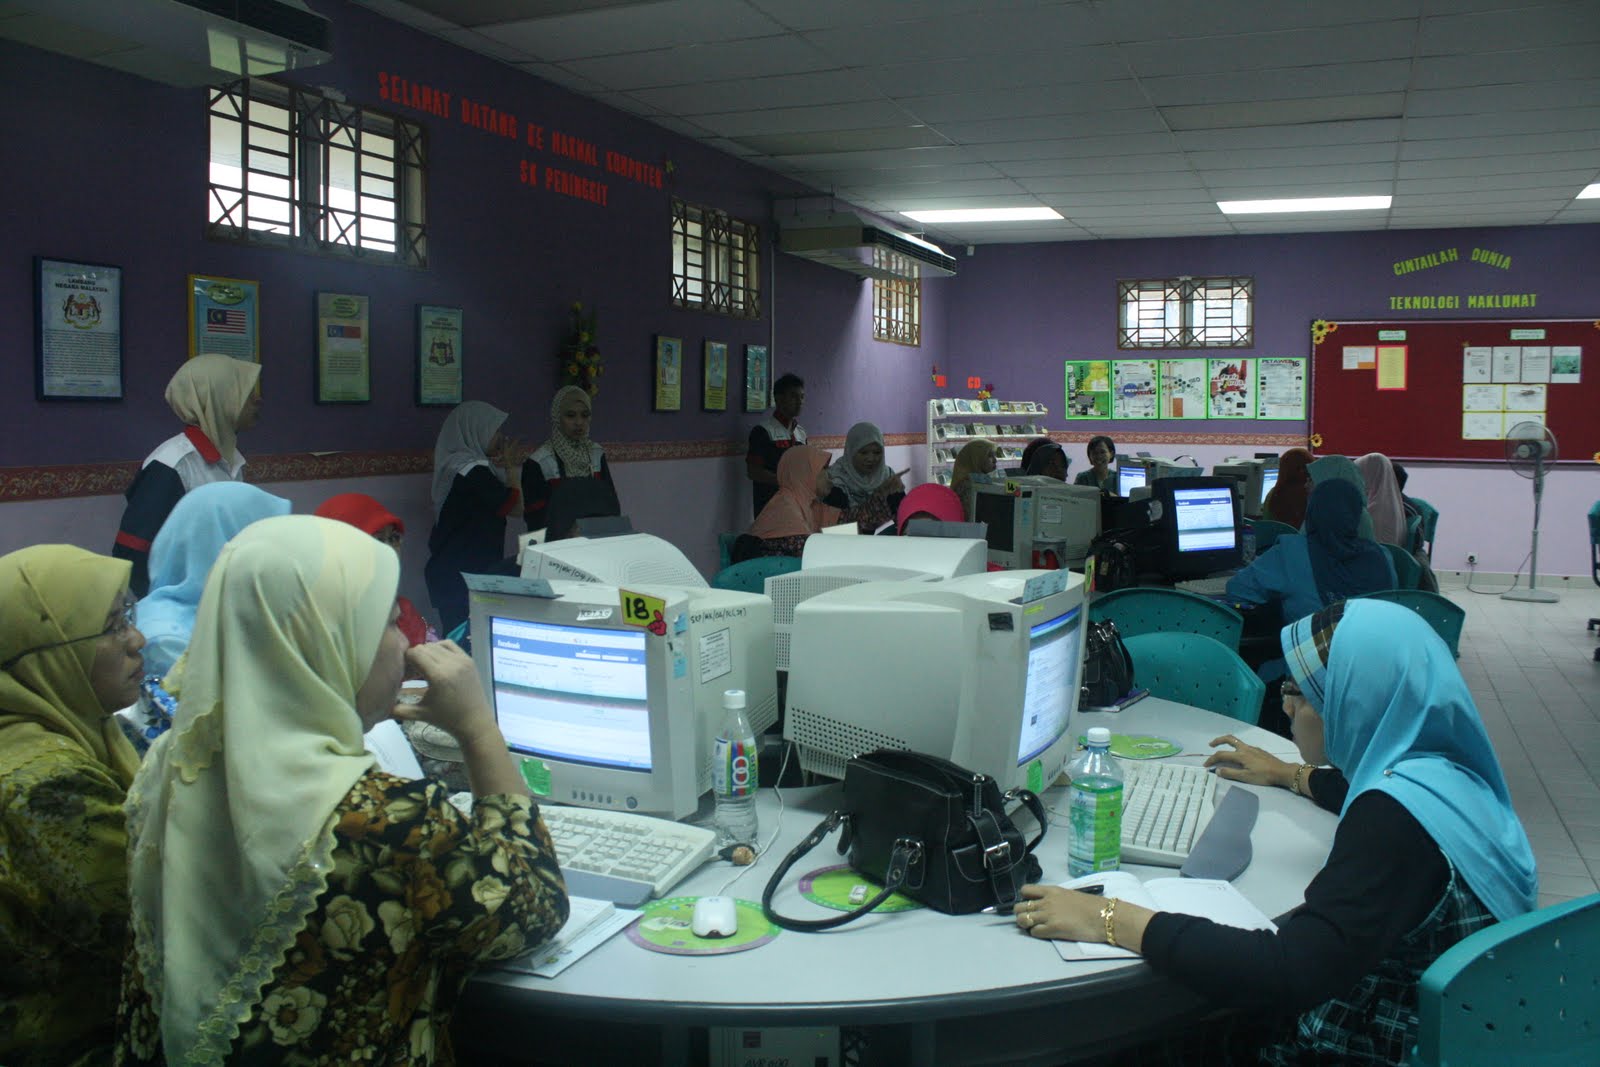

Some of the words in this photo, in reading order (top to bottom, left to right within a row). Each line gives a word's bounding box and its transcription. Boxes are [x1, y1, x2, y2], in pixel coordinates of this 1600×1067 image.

[377, 72, 451, 119] SELAMAT
[461, 97, 518, 141] DATANG
[527, 122, 544, 151] KE
[519, 159, 538, 187] SK
[1393, 247, 1459, 276] CINTAILAH
[1471, 247, 1512, 271] DUNIA
[1390, 295, 1460, 310] TEKNOLOGI
[1468, 293, 1537, 309] MAKLUMAT
[625, 596, 650, 621] 18
[731, 755, 750, 792] 100
